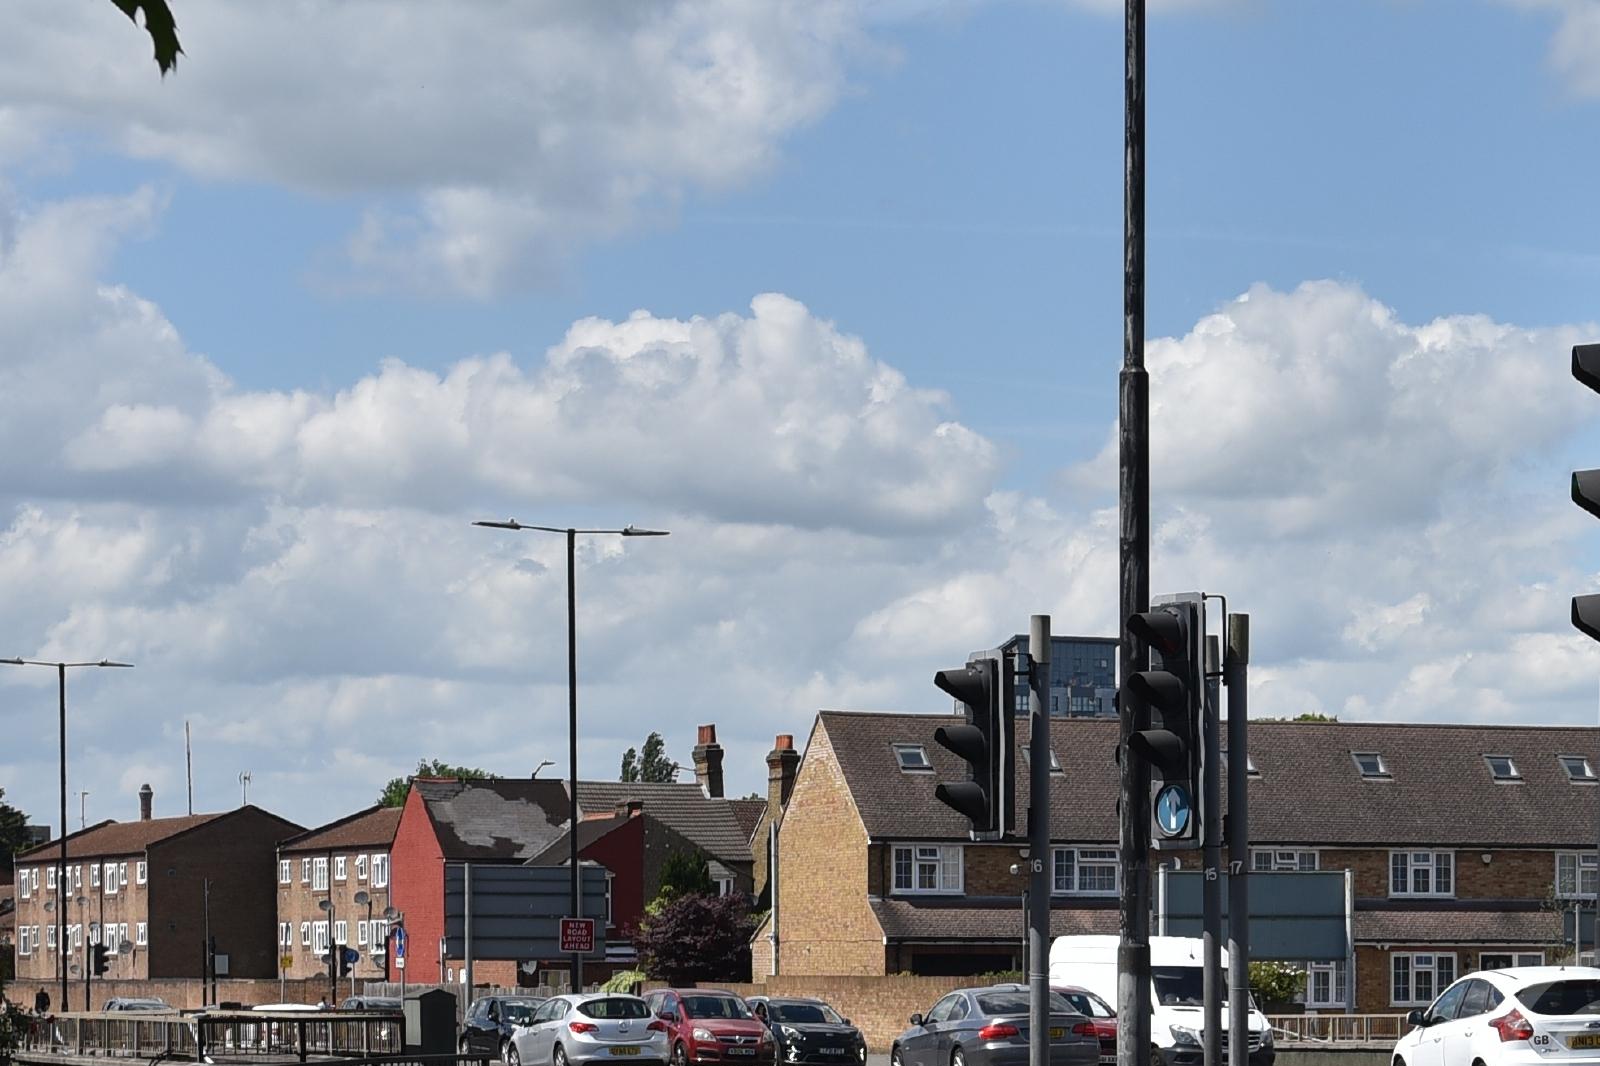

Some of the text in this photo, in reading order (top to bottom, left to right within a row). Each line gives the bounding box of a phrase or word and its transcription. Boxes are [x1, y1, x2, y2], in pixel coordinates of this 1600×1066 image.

[1030, 858, 1043, 873] 16
[1229, 860, 1243, 875] 17
[1204, 867, 1217, 881] 15
[1533, 1035, 1550, 1046] GB
